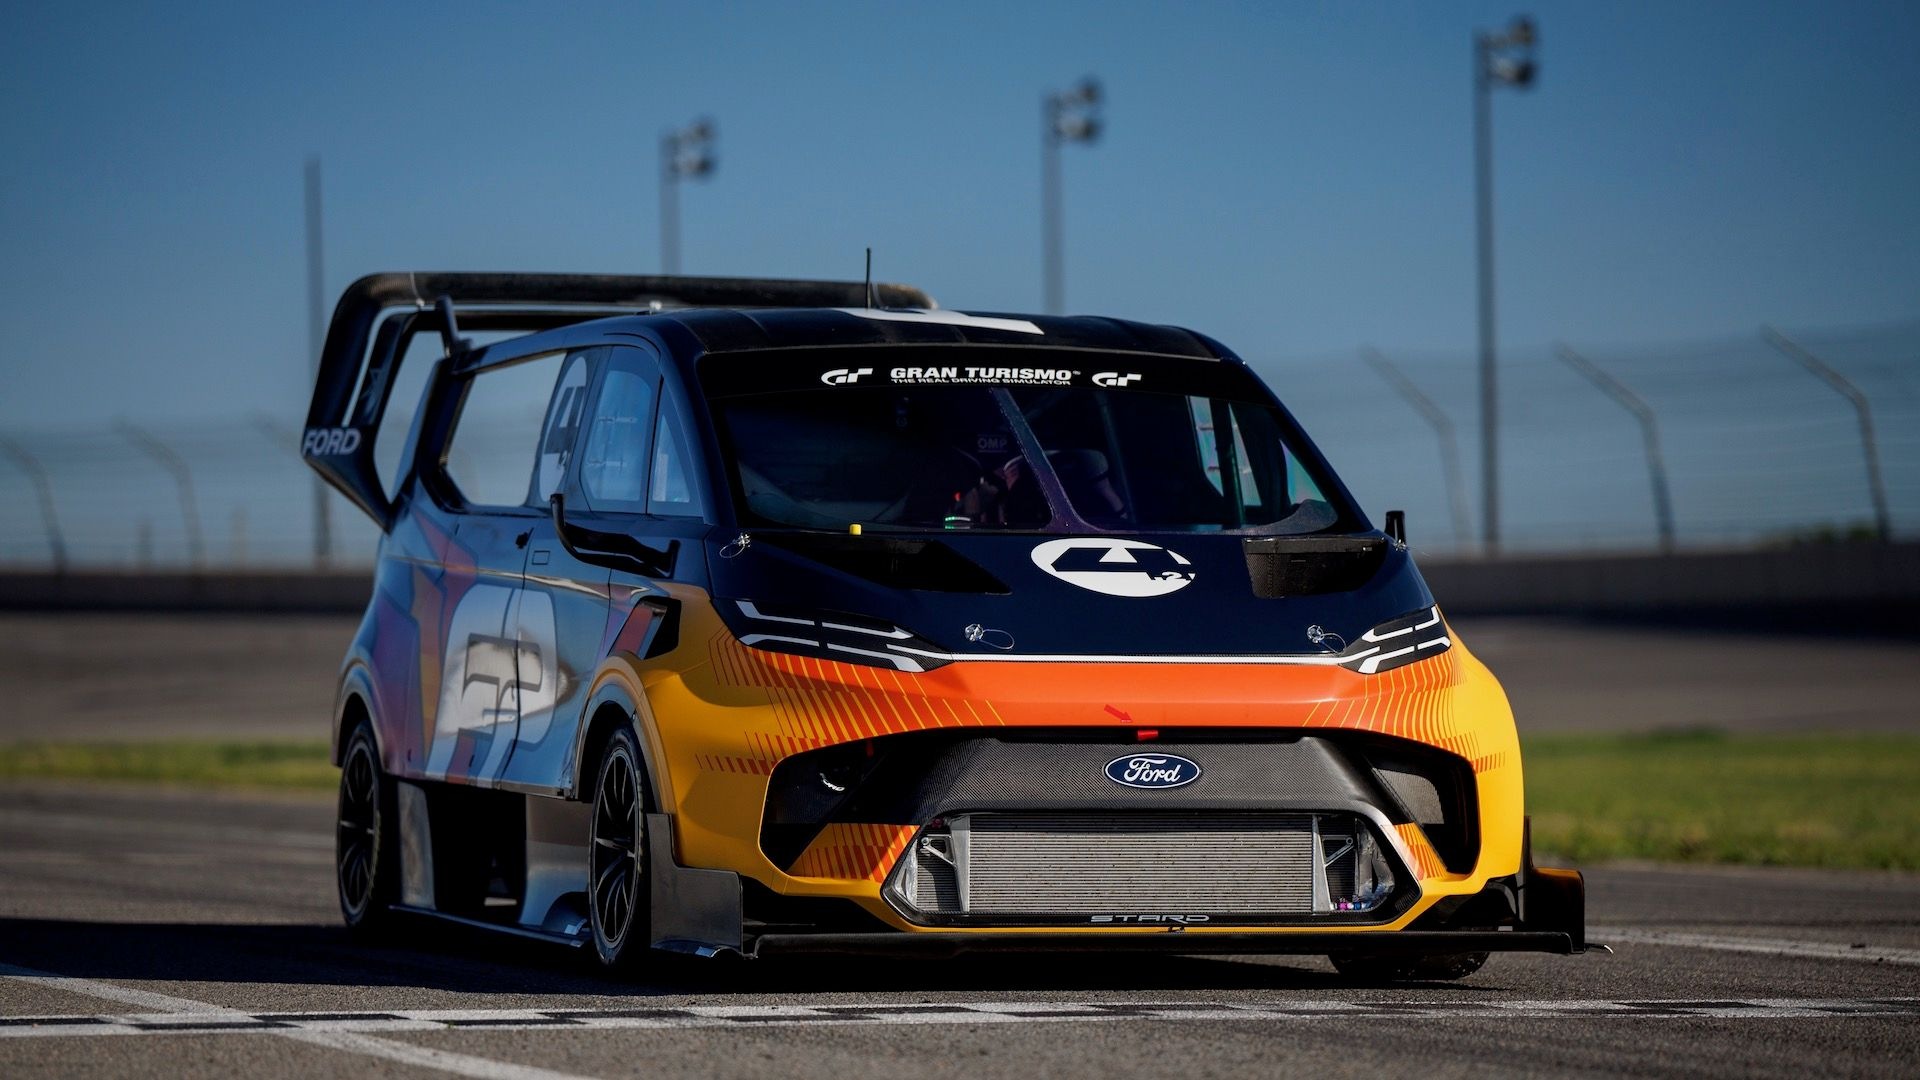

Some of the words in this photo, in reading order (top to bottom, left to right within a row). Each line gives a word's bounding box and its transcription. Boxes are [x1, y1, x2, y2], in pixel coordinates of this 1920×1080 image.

[890, 367, 957, 378] GRAN
[302, 428, 361, 456] FORD
[977, 437, 1008, 449] OMP
[1124, 757, 1182, 782] Ford
[1091, 914, 1210, 924] STARD
